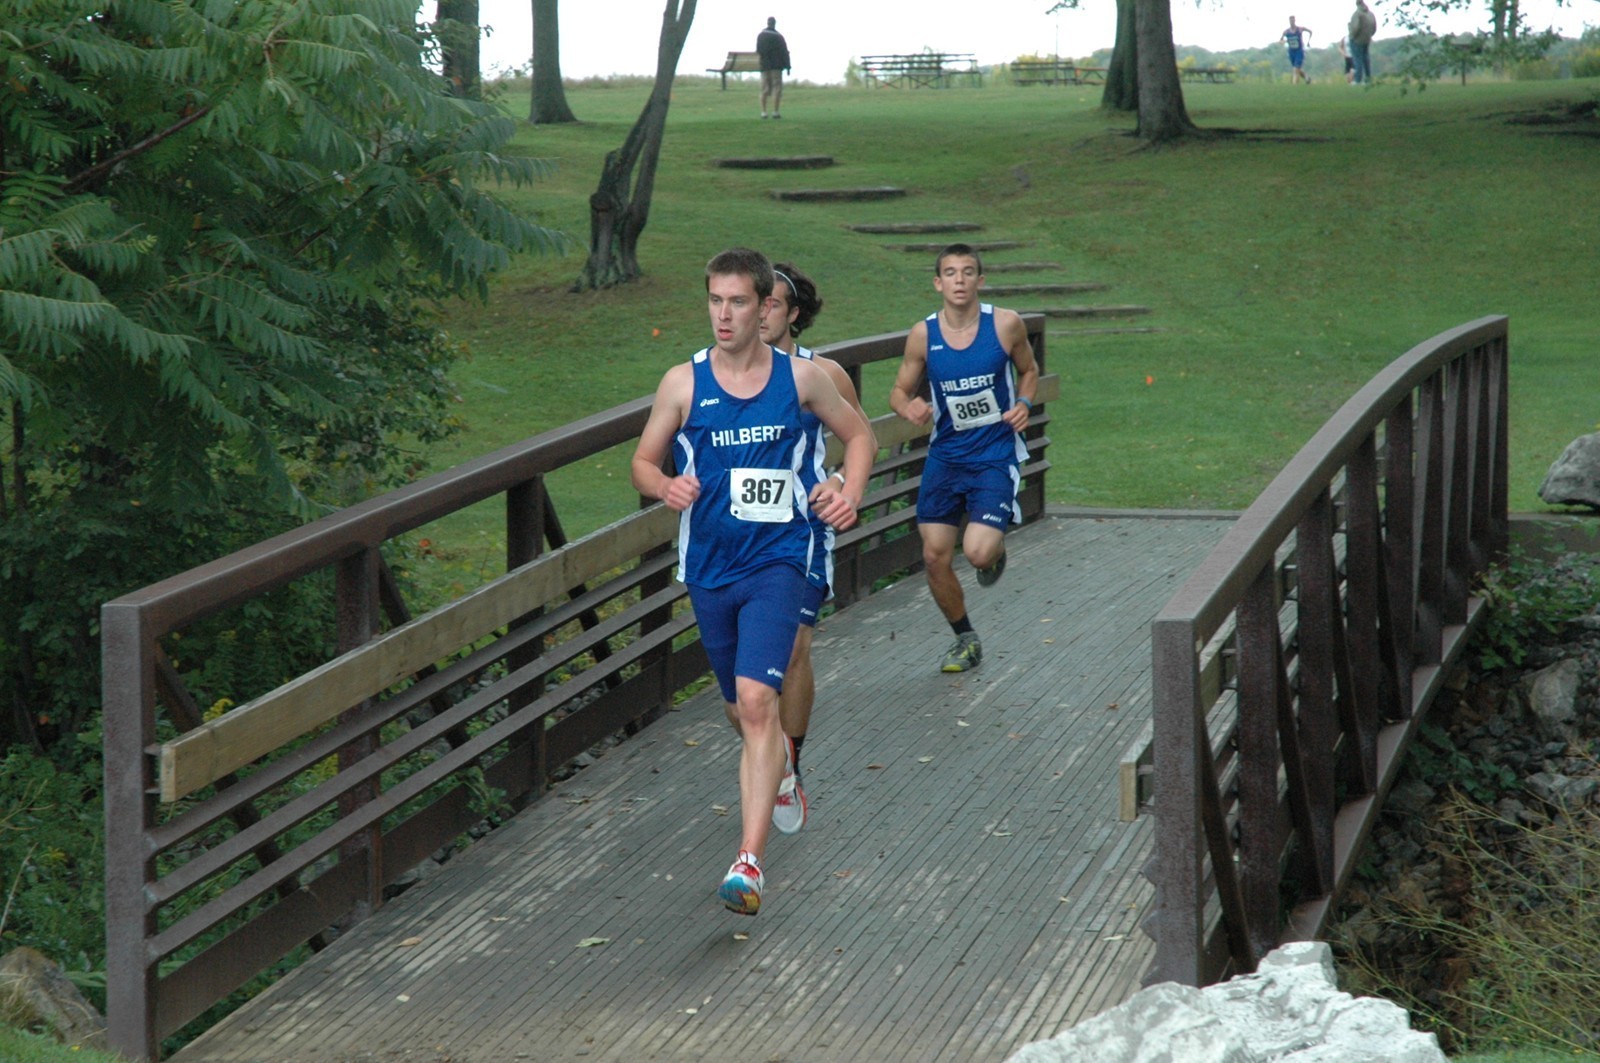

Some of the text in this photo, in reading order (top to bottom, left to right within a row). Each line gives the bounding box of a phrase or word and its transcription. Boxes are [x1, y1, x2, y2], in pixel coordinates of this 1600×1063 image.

[940, 374, 995, 392] HILBERT
[955, 398, 990, 419] 365
[711, 425, 785, 447] HILBERT
[741, 478, 786, 505] 367
